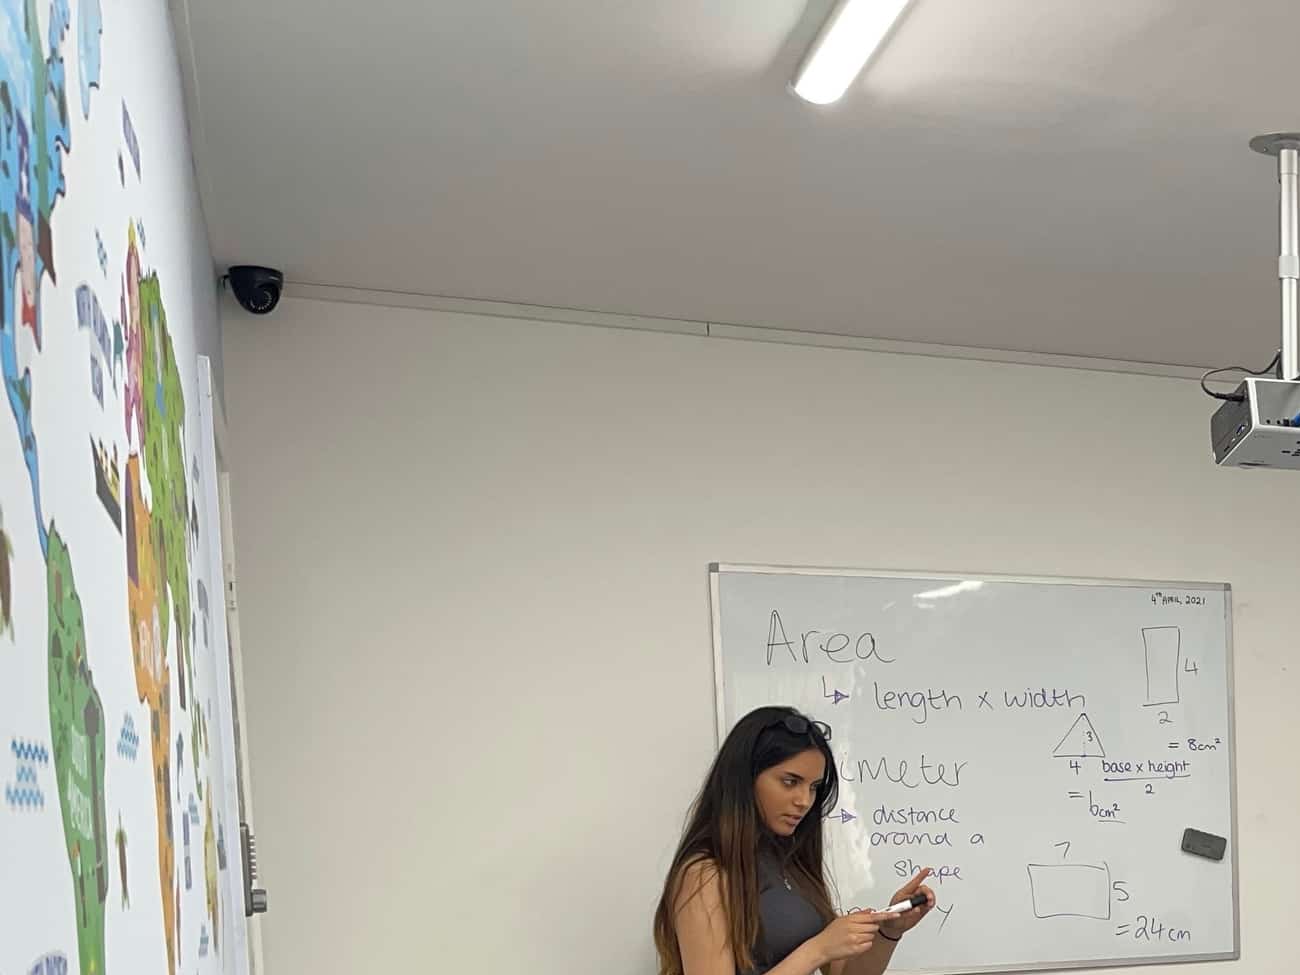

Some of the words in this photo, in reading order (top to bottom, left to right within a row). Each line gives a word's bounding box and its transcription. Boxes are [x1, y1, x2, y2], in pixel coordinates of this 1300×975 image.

[1185, 595, 1205, 605] 2021
[767, 609, 896, 666] Area
[1184, 658, 1199, 676] 4
[874, 681, 962, 724] length
[1004, 688, 1085, 708] width
[1157, 711, 1173, 724] 2
[1085, 730, 1094, 742] 3
[1069, 760, 1082, 776] 4
[1101, 760, 1131, 773] base
[1148, 760, 1191, 779] height
[1145, 784, 1155, 794] 2
[873, 804, 960, 825] distance
[870, 832, 953, 847] around
[969, 833, 985, 845] a
[1112, 881, 1130, 901] 5
